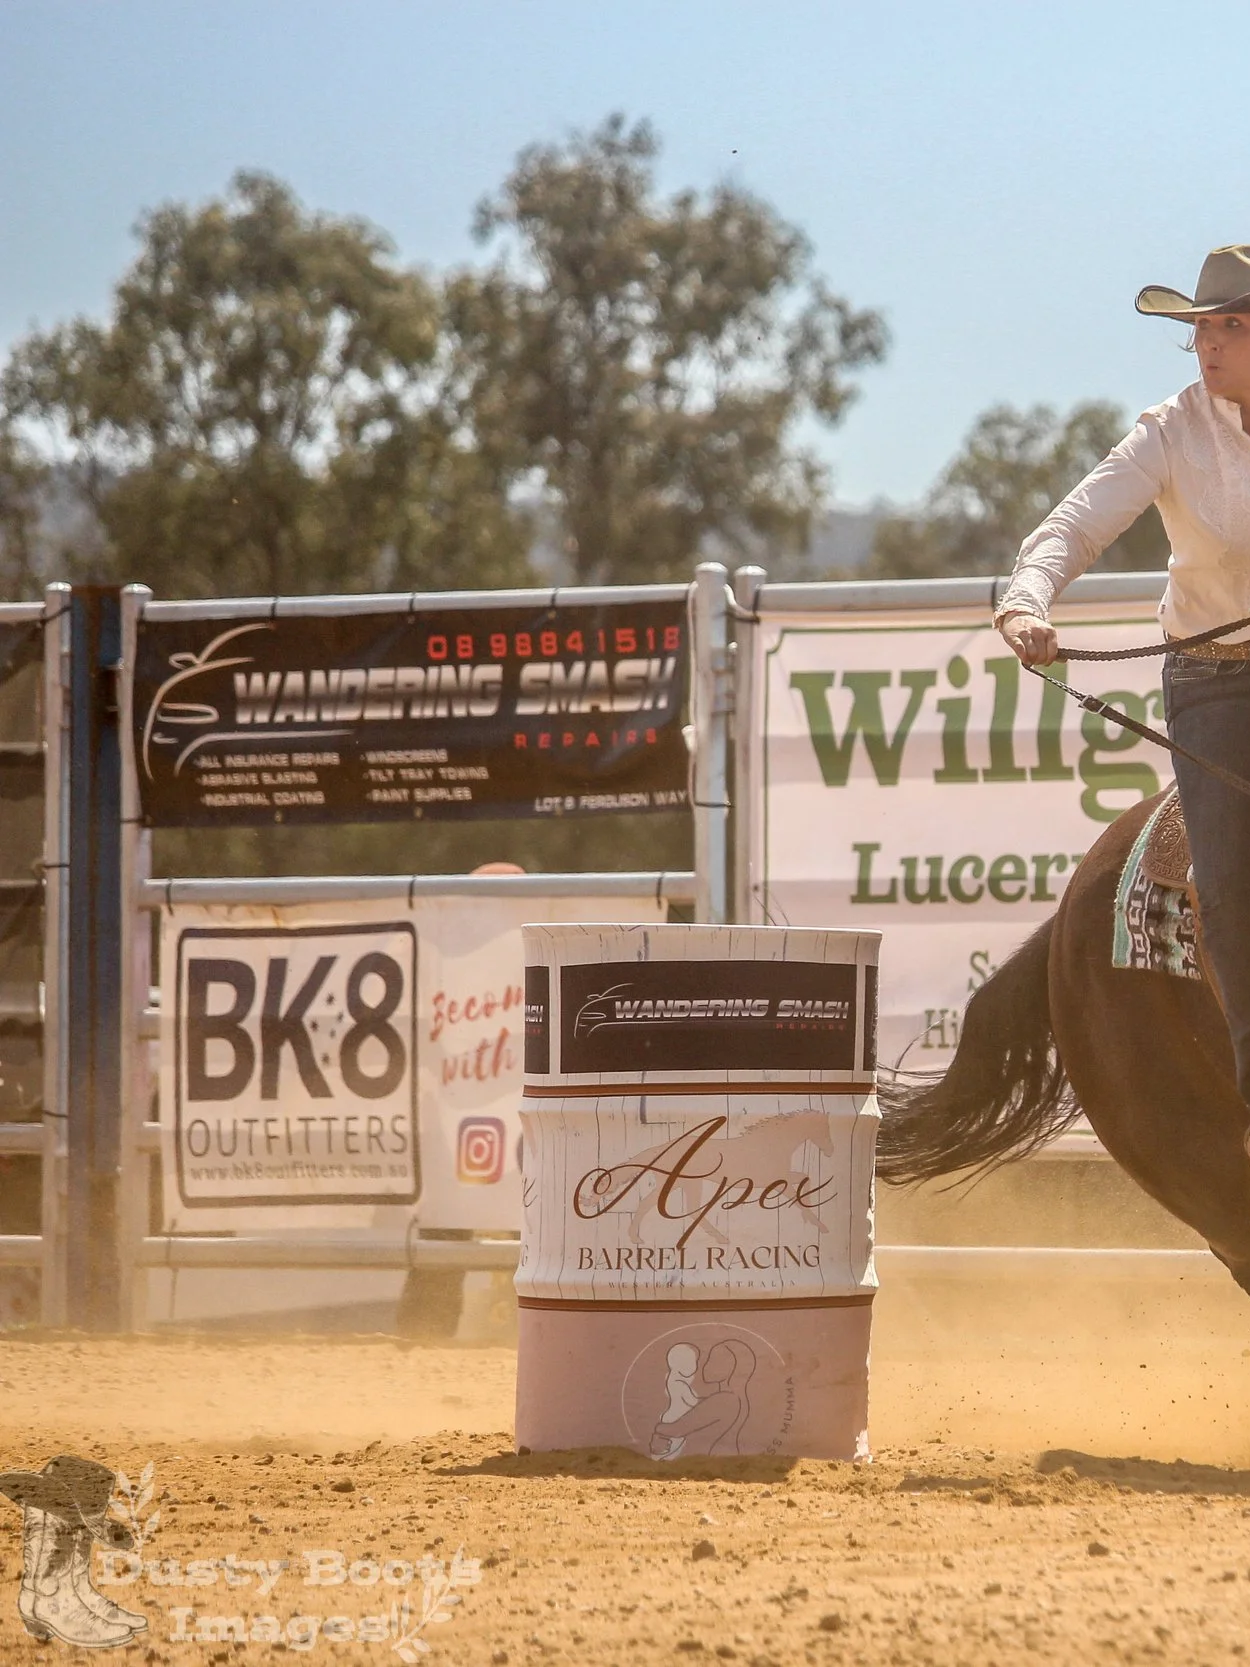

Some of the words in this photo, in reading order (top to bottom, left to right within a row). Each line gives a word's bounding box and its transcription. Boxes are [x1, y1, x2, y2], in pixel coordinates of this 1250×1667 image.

[427, 634, 473, 660] 08
[233, 664, 502, 725] WANDERING
[516, 657, 677, 716] SMASH
[513, 727, 658, 749] REPAIRS
[789, 655, 1163, 823] Willg
[653, 789, 688, 806] WAY
[850, 843, 1086, 904] Lucer
[187, 951, 406, 1101] BK8
[615, 999, 770, 1019] WANDERING
[776, 999, 849, 1019] SMASH
[187, 1114, 408, 1158] OUTFITTERS
[573, 1115, 838, 1251] Apex
[577, 1246, 697, 1271] BARREL
[706, 1244, 820, 1270] RACING
